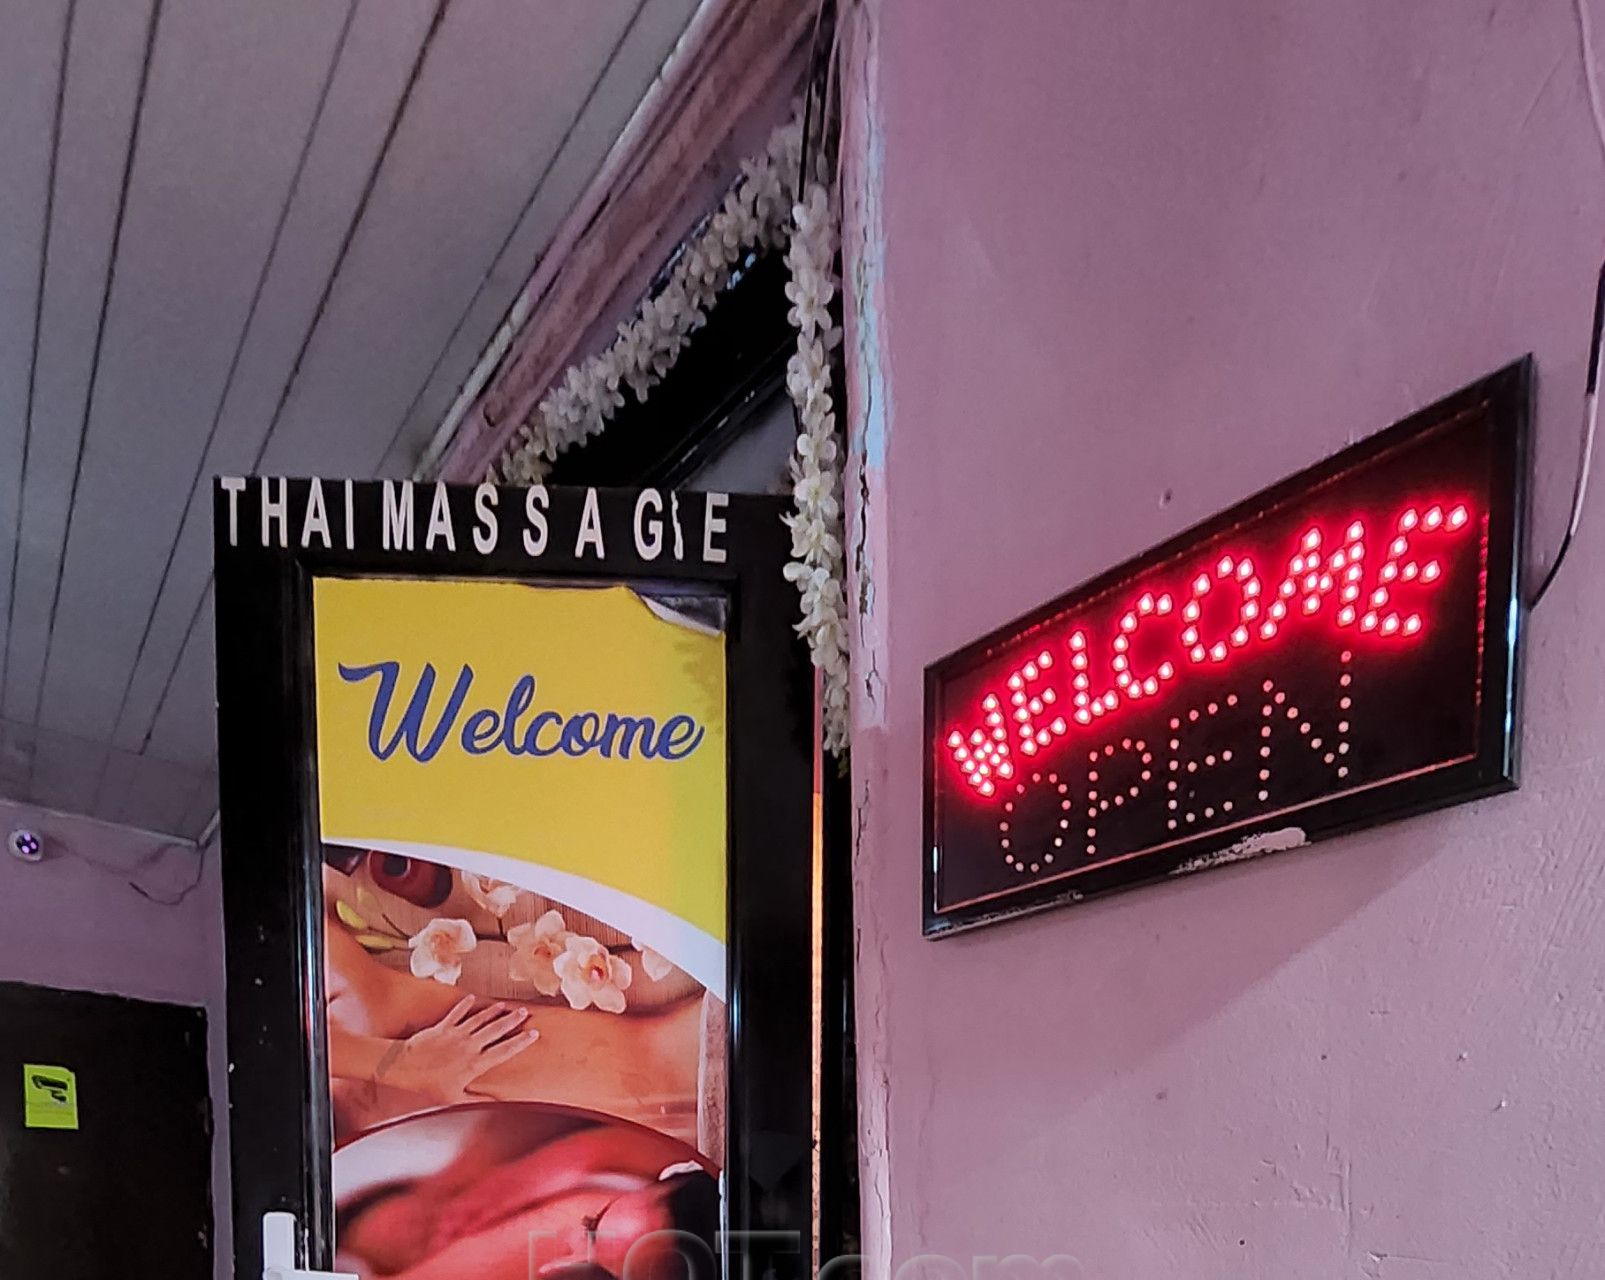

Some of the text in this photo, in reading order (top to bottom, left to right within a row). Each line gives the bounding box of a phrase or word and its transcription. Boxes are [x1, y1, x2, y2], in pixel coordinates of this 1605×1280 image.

[221, 476, 355, 550] THAI
[338, 661, 705, 763] Welcome
[946, 502, 1470, 798] WELCOME
[999, 649, 1353, 875] OPEN
